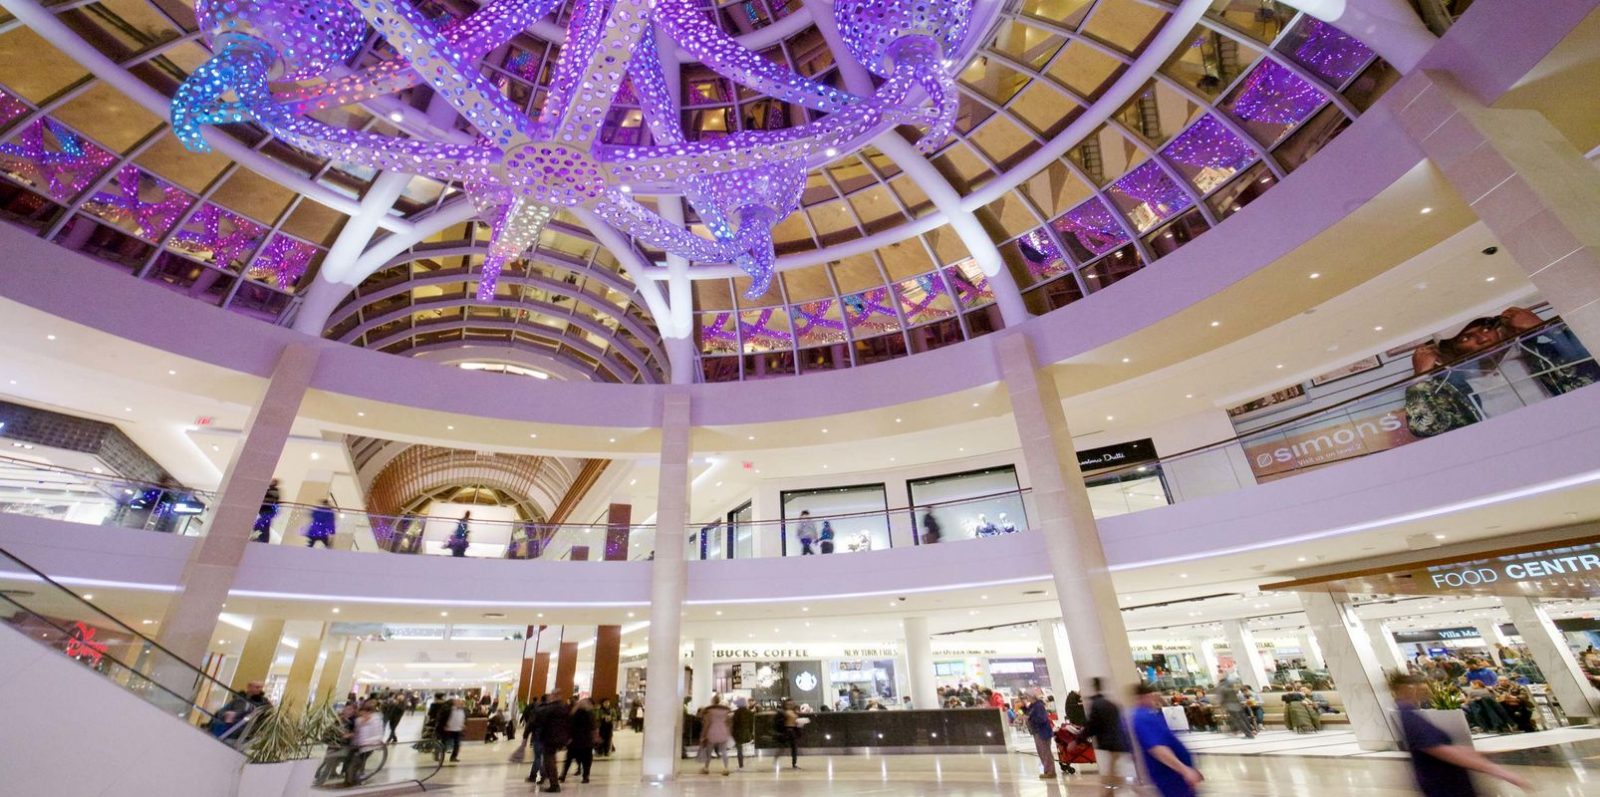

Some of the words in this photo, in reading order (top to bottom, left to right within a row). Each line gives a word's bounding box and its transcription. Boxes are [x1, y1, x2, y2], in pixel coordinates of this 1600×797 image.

[1274, 415, 1402, 462] simons
[1102, 452, 1126, 462] Dutti
[1432, 568, 1498, 588] FOOD
[1439, 630, 1462, 639] Villa
[763, 649, 809, 658] COFFEE
[843, 649, 859, 657] NEW
